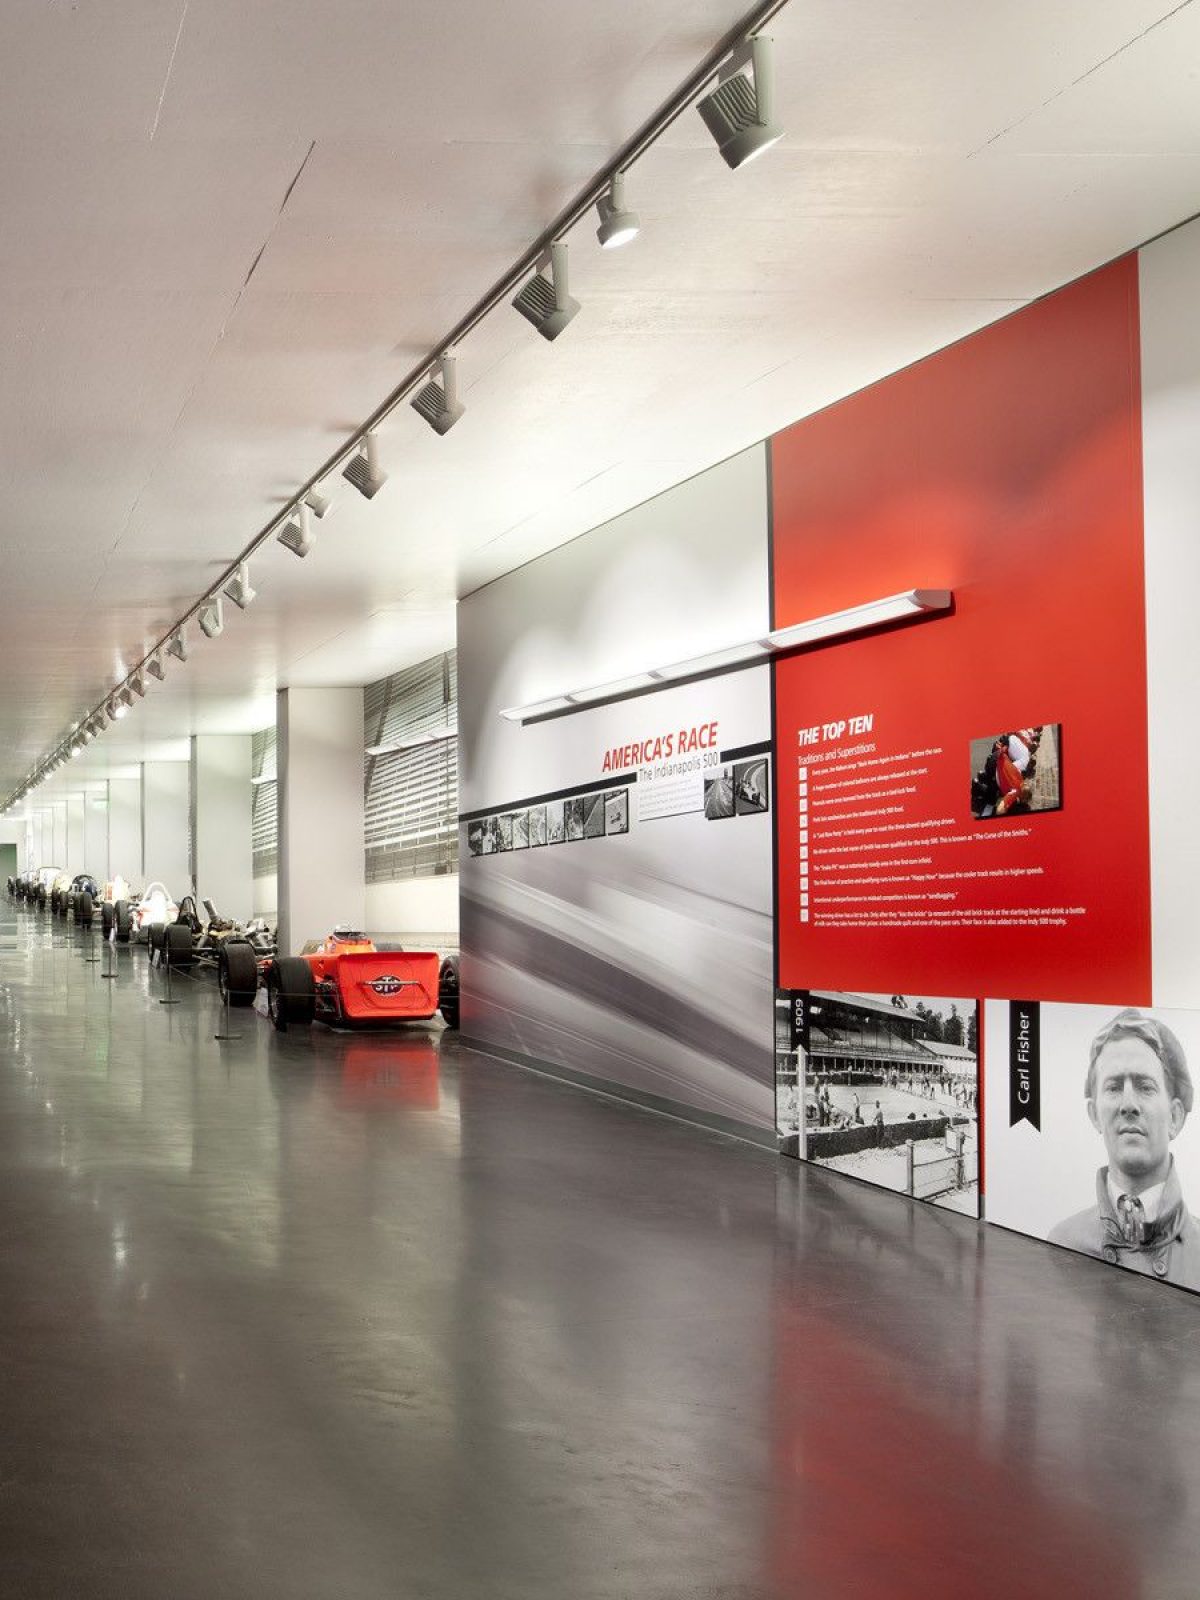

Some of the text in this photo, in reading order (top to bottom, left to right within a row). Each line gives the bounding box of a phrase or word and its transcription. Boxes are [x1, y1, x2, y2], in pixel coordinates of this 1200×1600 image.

[798, 714, 873, 746] THE TOP TEN
[603, 722, 719, 772] AMERICA'S RACE
[799, 742, 877, 765] Traditions and Superstitions
[654, 758, 701, 778] Indianapolis
[703, 751, 718, 770] 500
[795, 998, 804, 1033] 1909
[1017, 1011, 1030, 1104] Carl Fisher
